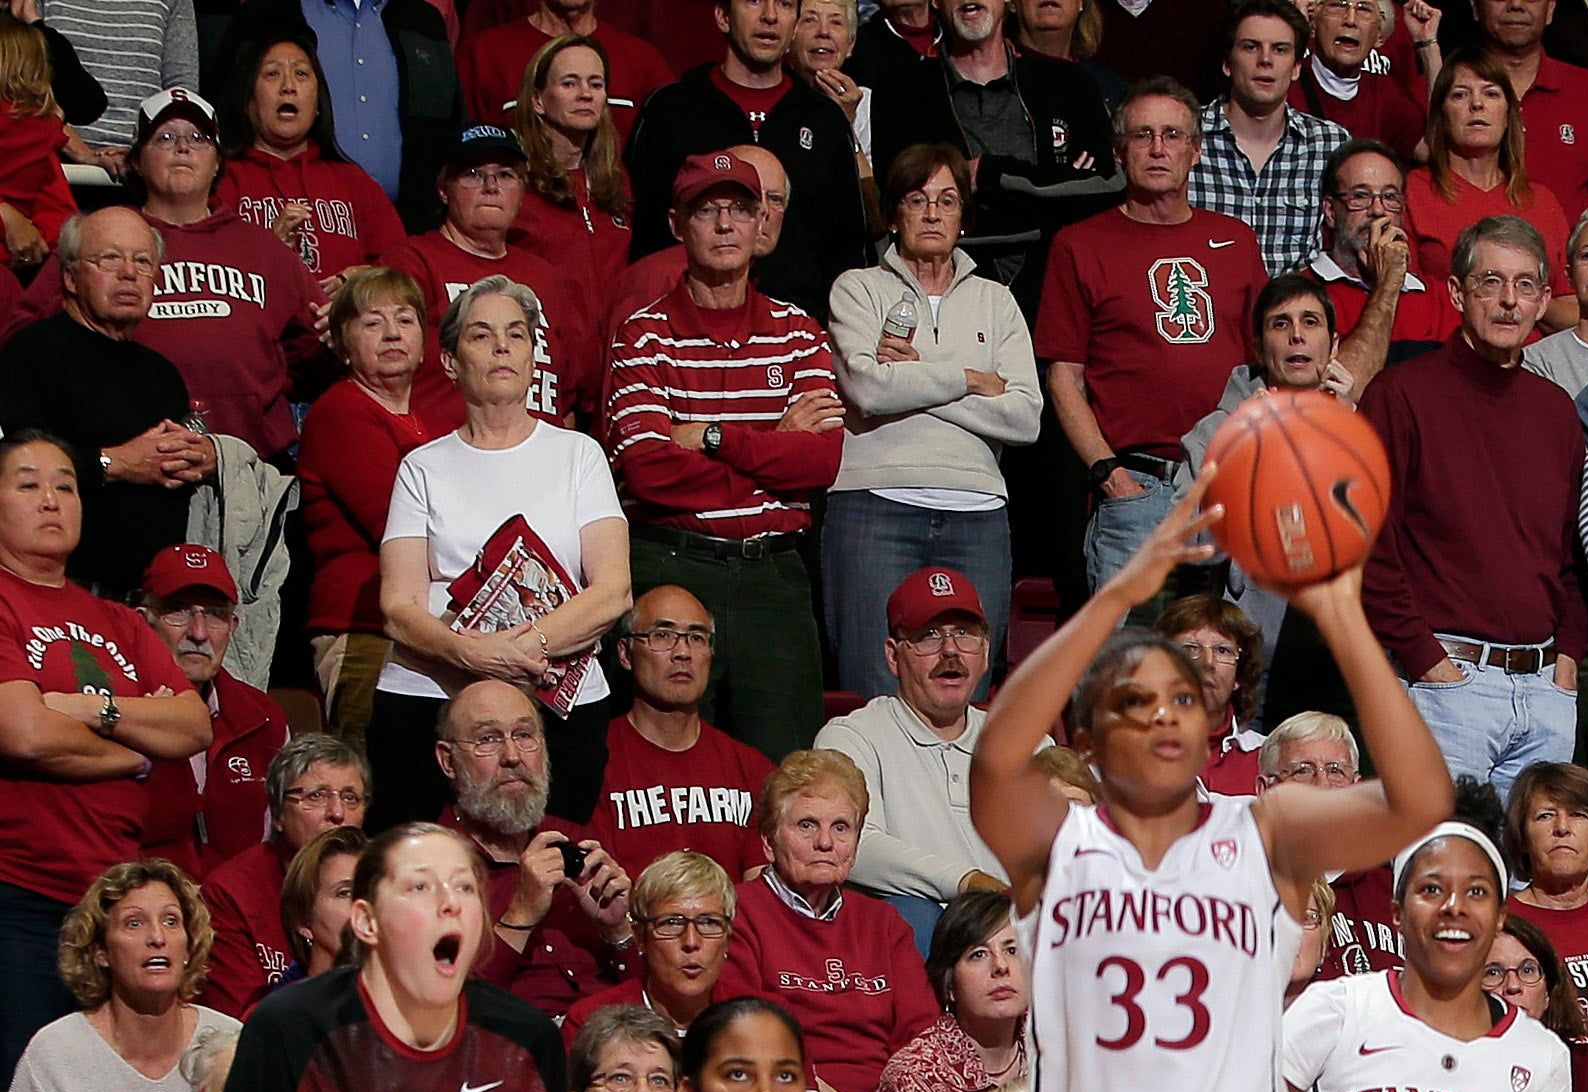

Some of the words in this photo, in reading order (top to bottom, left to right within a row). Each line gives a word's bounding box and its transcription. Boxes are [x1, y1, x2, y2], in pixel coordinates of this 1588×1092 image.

[153, 261, 266, 309] NFORD
[1147, 257, 1215, 344] S
[156, 302, 220, 316] RUGBY
[766, 365, 784, 388] S
[65, 621, 104, 648] The
[610, 785, 671, 830] THE
[670, 786, 752, 829] FARM
[1051, 888, 1258, 959] STANFORD
[825, 958, 845, 983] S
[1095, 955, 1211, 1051] 33
